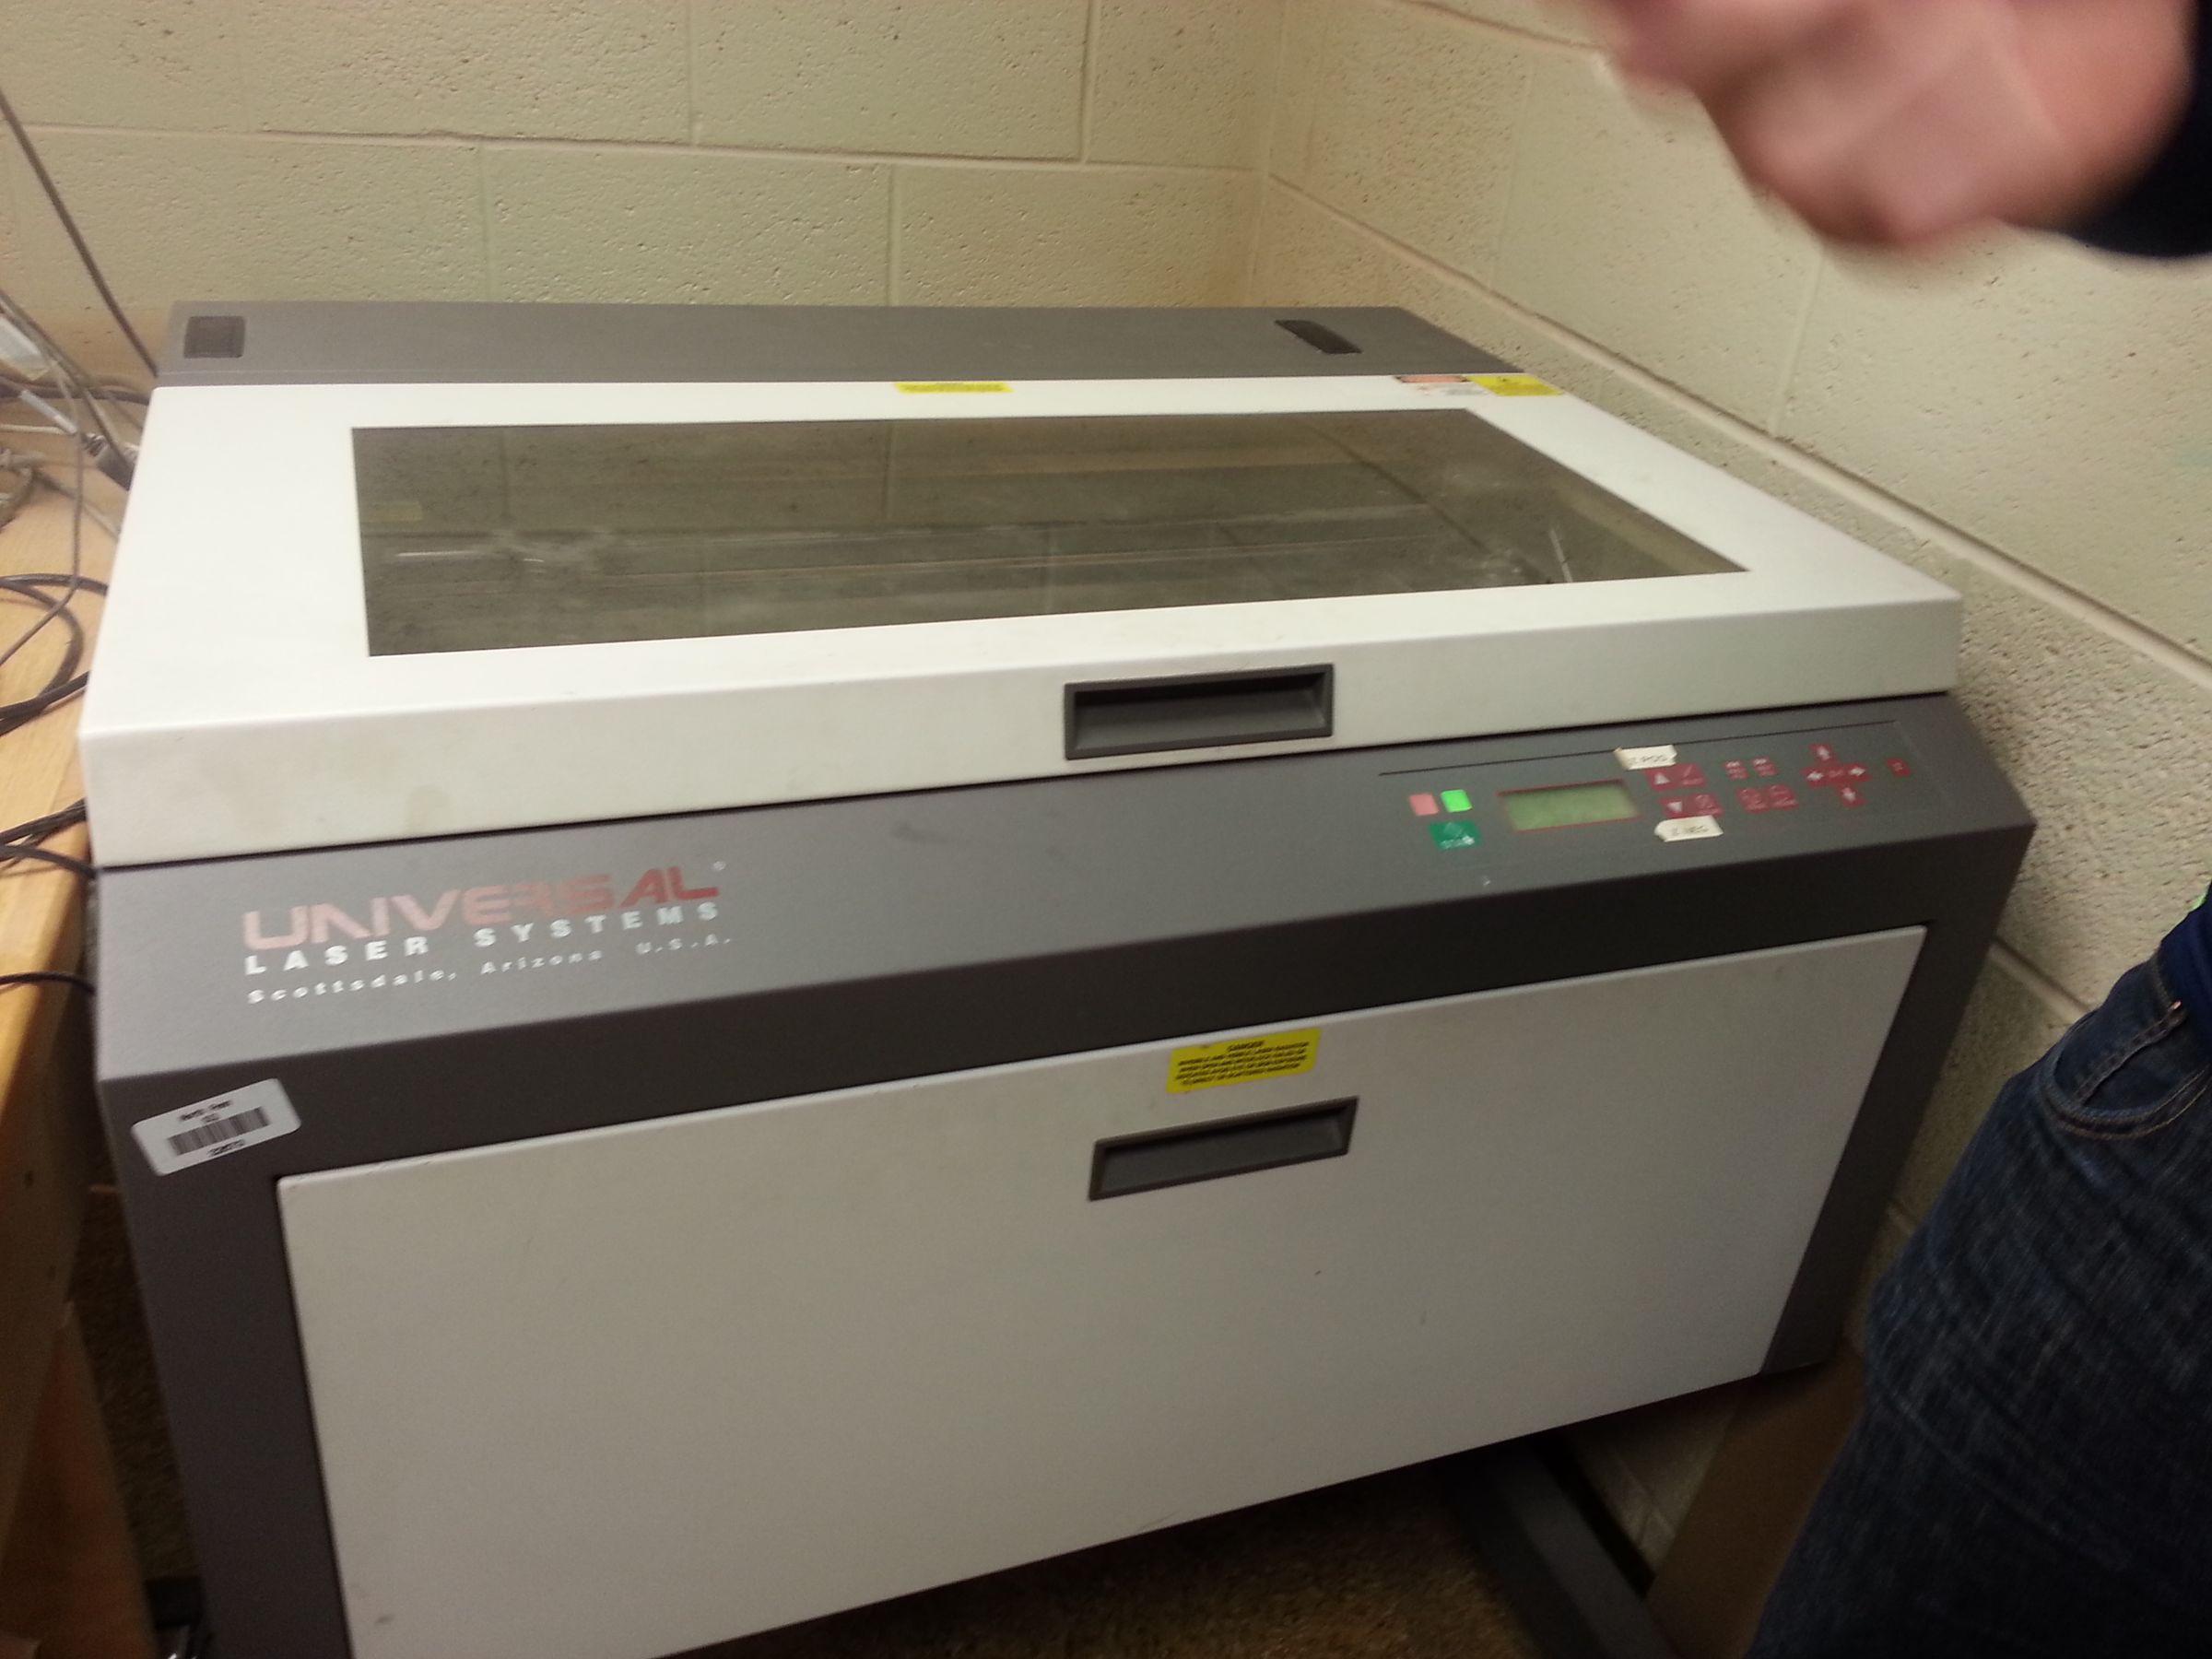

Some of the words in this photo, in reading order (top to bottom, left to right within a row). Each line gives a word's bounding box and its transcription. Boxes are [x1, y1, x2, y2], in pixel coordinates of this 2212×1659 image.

[243, 866, 719, 950] UNIVERSAL
[244, 935, 429, 975] LASER
[473, 901, 719, 947] SYSTEMS
[247, 970, 456, 1005] Scottsdale,
[480, 950, 603, 974] Arizona
[635, 934, 732, 955] U.S.A.
